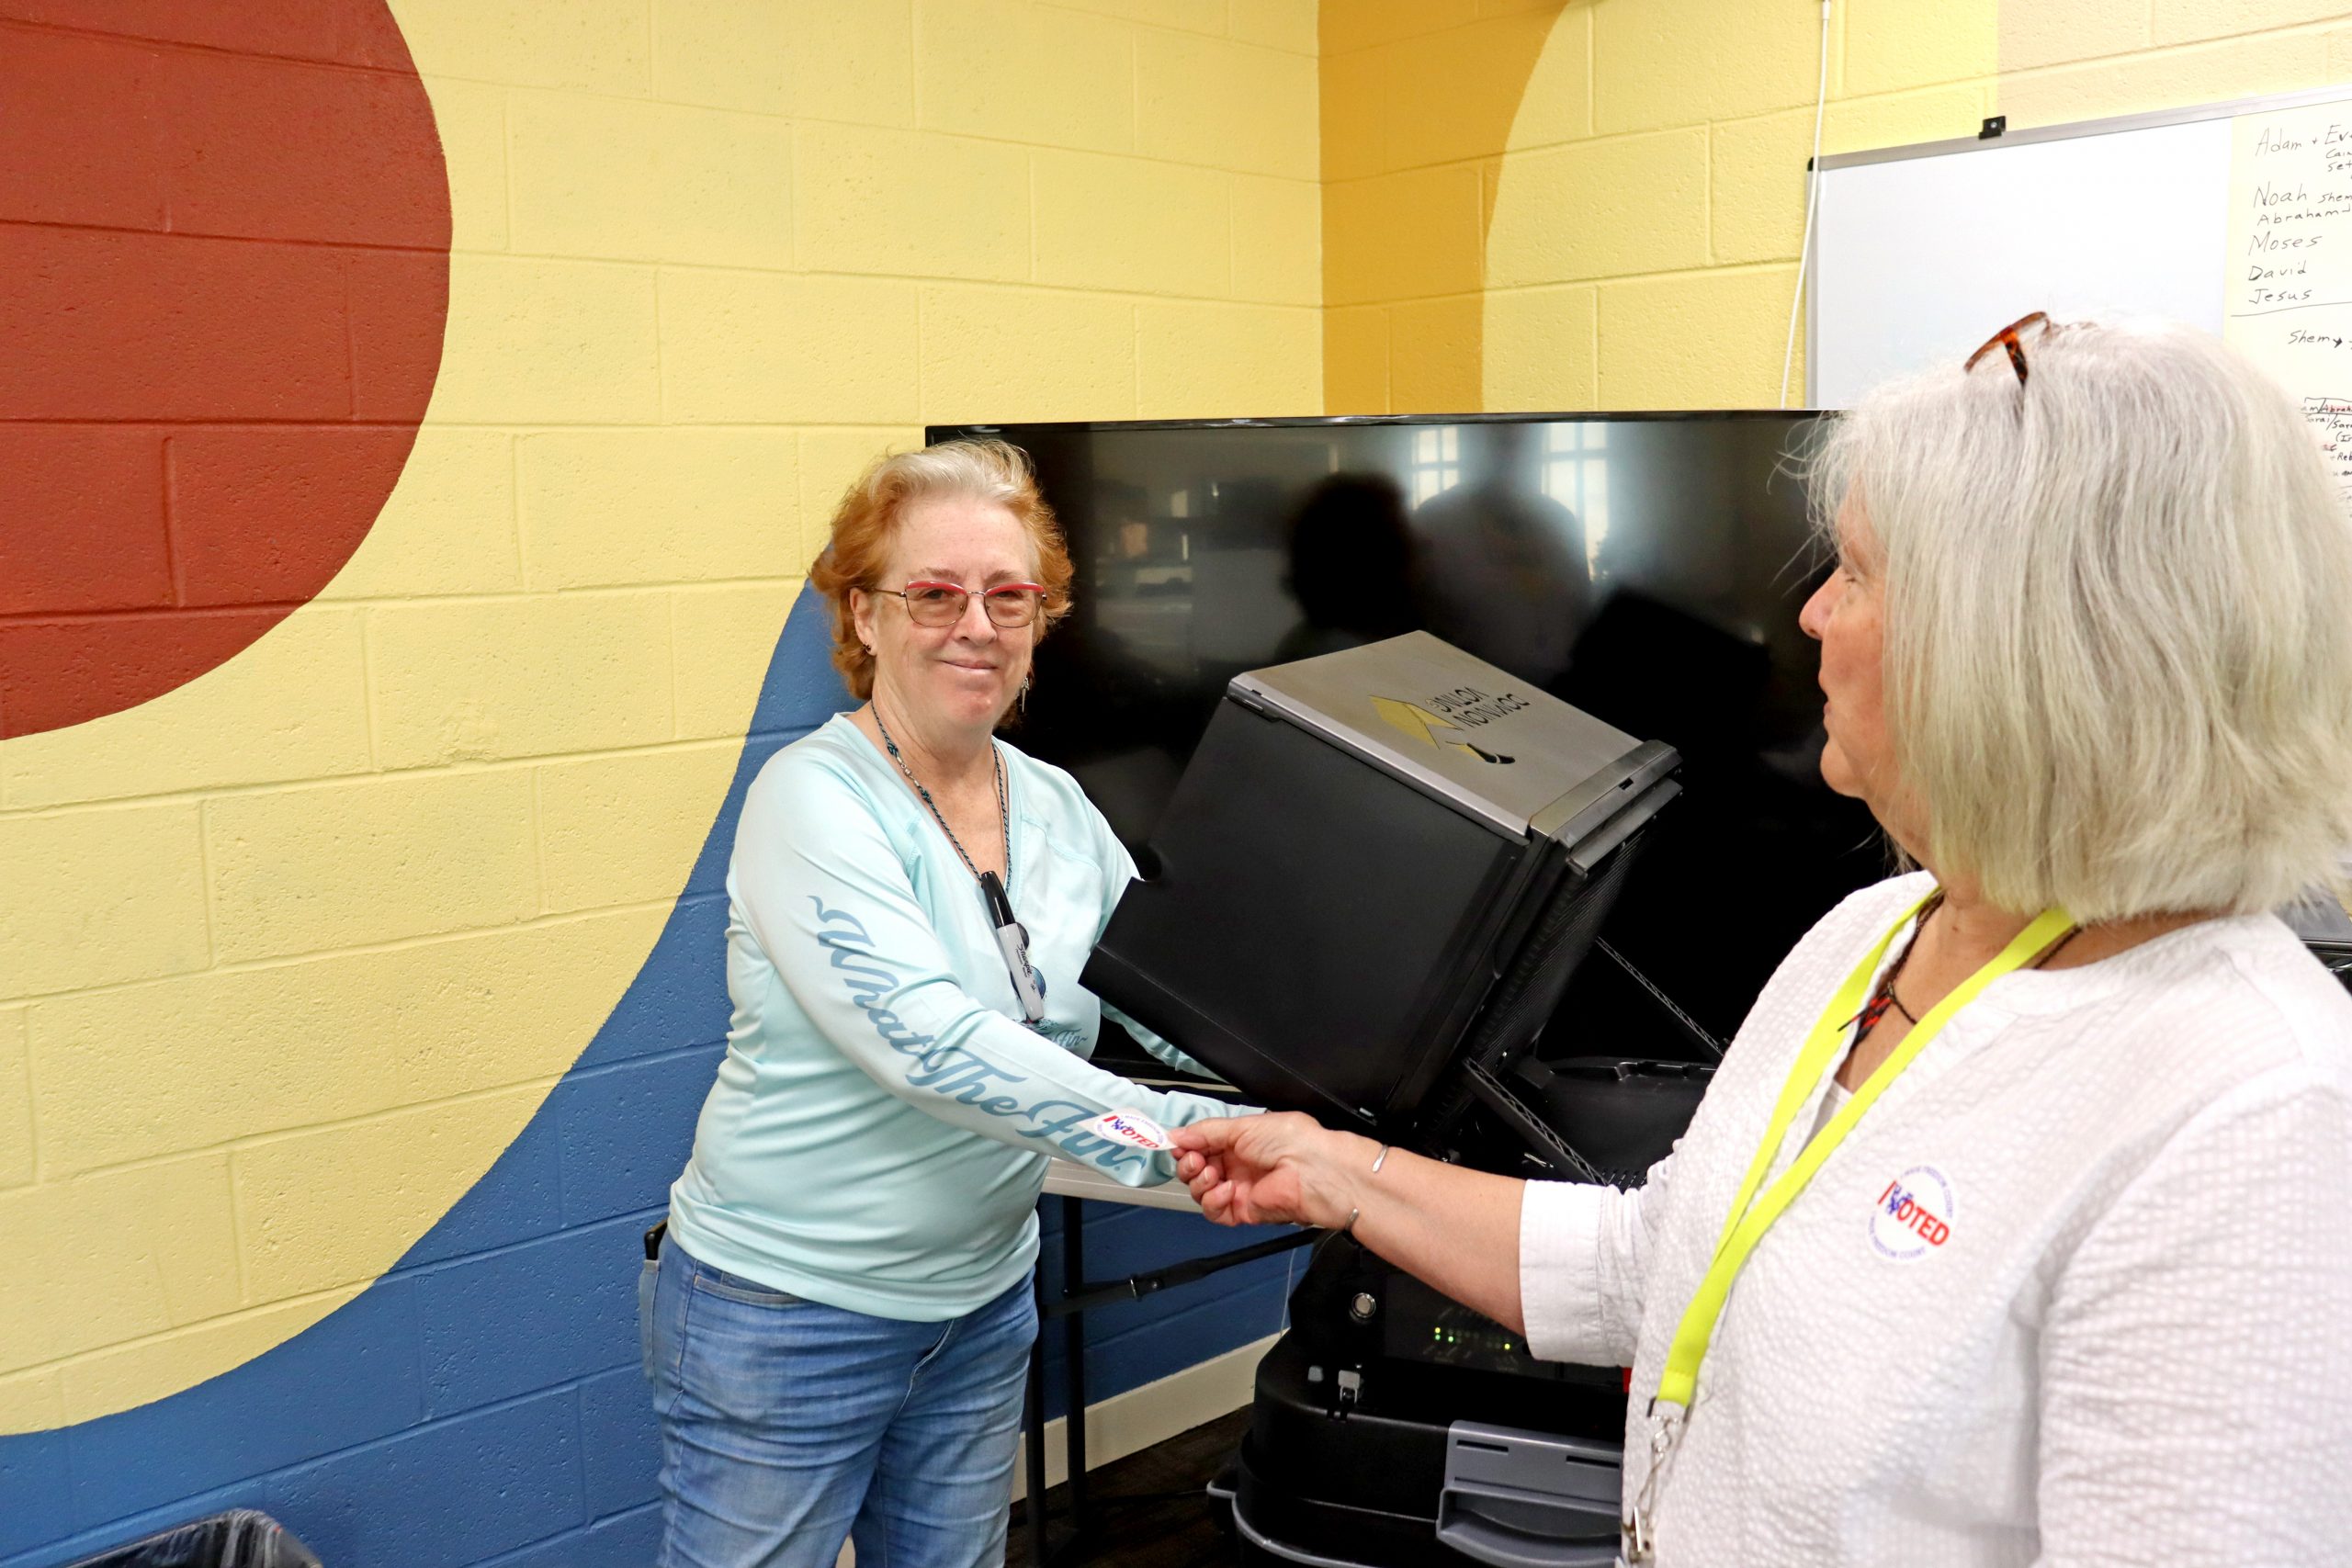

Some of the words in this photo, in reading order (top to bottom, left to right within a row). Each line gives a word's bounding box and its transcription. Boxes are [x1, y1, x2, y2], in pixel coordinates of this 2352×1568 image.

[2256, 127, 2301, 157] Adam
[2254, 181, 2307, 209] Noah
[2257, 208, 2338, 227] Abraham
[2248, 231, 2323, 256] Moses
[2248, 260, 2307, 282] David
[2248, 288, 2312, 305] Jesus
[2288, 330, 2331, 344] Shem
[1453, 694, 1531, 728] DOMINION
[807, 895, 936, 1062] What
[905, 1045, 1031, 1119] The
[1877, 1180, 1897, 1205] I
